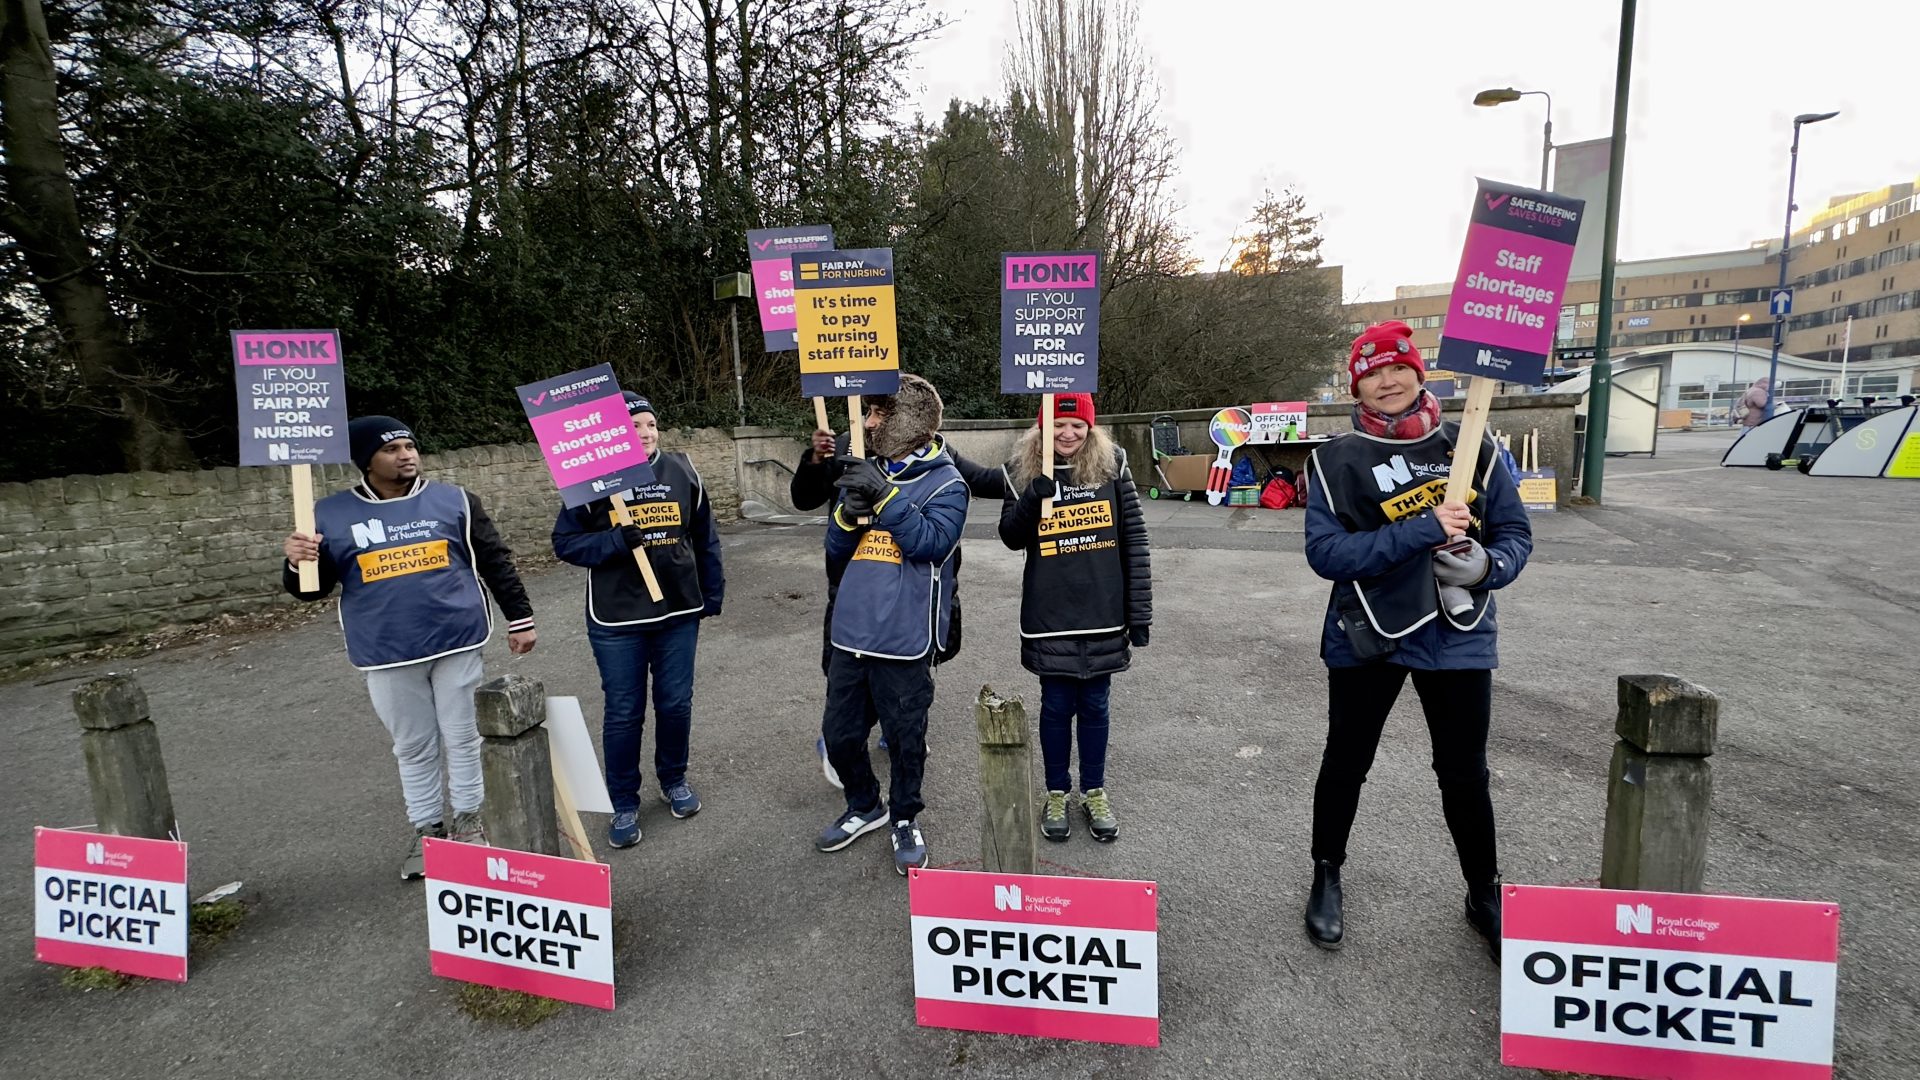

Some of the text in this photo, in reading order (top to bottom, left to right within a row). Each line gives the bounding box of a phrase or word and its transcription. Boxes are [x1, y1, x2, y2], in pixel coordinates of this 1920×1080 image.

[1510, 197, 1576, 222] SAFE STAFFING
[1507, 207, 1563, 228] SAVES LIVES
[794, 235, 828, 244] STAFFING
[822, 260, 864, 270] FAIR PAY
[1496, 249, 1543, 274] Staff
[822, 268, 886, 279] FOR NURSING
[1012, 262, 1090, 283] HONK
[1465, 272, 1554, 304] shortages
[812, 294, 877, 309] It's time
[1026, 292, 1074, 306] IF YOU
[770, 304, 796, 315] cos
[1014, 307, 1086, 320] SUPPORT
[1463, 301, 1504, 320] cost
[1505, 304, 1545, 329] lives
[822, 314, 870, 327] to pay
[1628, 318, 1650, 326] NHS
[817, 328, 878, 344] nursing
[1016, 322, 1085, 336] FAIR PAY
[244, 340, 330, 360] HONK
[1034, 338, 1066, 351] FOR
[808, 345, 888, 360] staff fairly
[1014, 353, 1085, 366] NURSING
[263, 368, 316, 380] IF YOU
[252, 382, 330, 395] SUPPORT
[549, 374, 610, 396] SAFE STAFFING
[552, 384, 600, 402] SAVES LIVES
[253, 396, 330, 410] FAIR PAY
[274, 412, 310, 424] FOR
[564, 412, 602, 432] Staff
[1255, 414, 1302, 422] OFFICIAL
[254, 425, 334, 438] NURSING
[1212, 421, 1250, 433] proud
[551, 424, 628, 454] shortages
[561, 442, 632, 470] cost lives
[1429, 464, 1452, 473] Colle
[1062, 485, 1079, 494] Royal
[1072, 491, 1096, 500] Nursing
[1392, 492, 1424, 512] THE
[642, 506, 674, 515] VOICE
[1045, 504, 1104, 520] HE VOICE
[388, 520, 438, 534] Royal College
[632, 514, 679, 526] NURSING
[1040, 514, 1110, 532] OF NURSING
[390, 529, 431, 541] of Nursing
[652, 532, 667, 540] PAY
[652, 537, 680, 546] NURSIN
[867, 534, 894, 545] CKET
[1058, 534, 1097, 546] FAIR PAY
[1060, 540, 1116, 554] FOR NURSING
[378, 546, 428, 563] PICKET
[366, 555, 446, 578] SUPERVISOR
[510, 868, 545, 882] Royal College
[45, 876, 176, 916] OFFICIAL
[1025, 895, 1072, 906] Royal College
[438, 889, 600, 941] OFFICIAL
[1025, 904, 1061, 916] of Nursing
[59, 909, 160, 944] PICKET
[1656, 916, 1720, 930] Royal College
[1656, 926, 1705, 940] of Nursing
[458, 924, 582, 970] PICKET
[928, 926, 1142, 970] OFFICIAL
[952, 964, 1118, 1006] PICKET
[1523, 951, 1813, 1008] OFFICIAL
[1554, 996, 1778, 1048] PICKET
